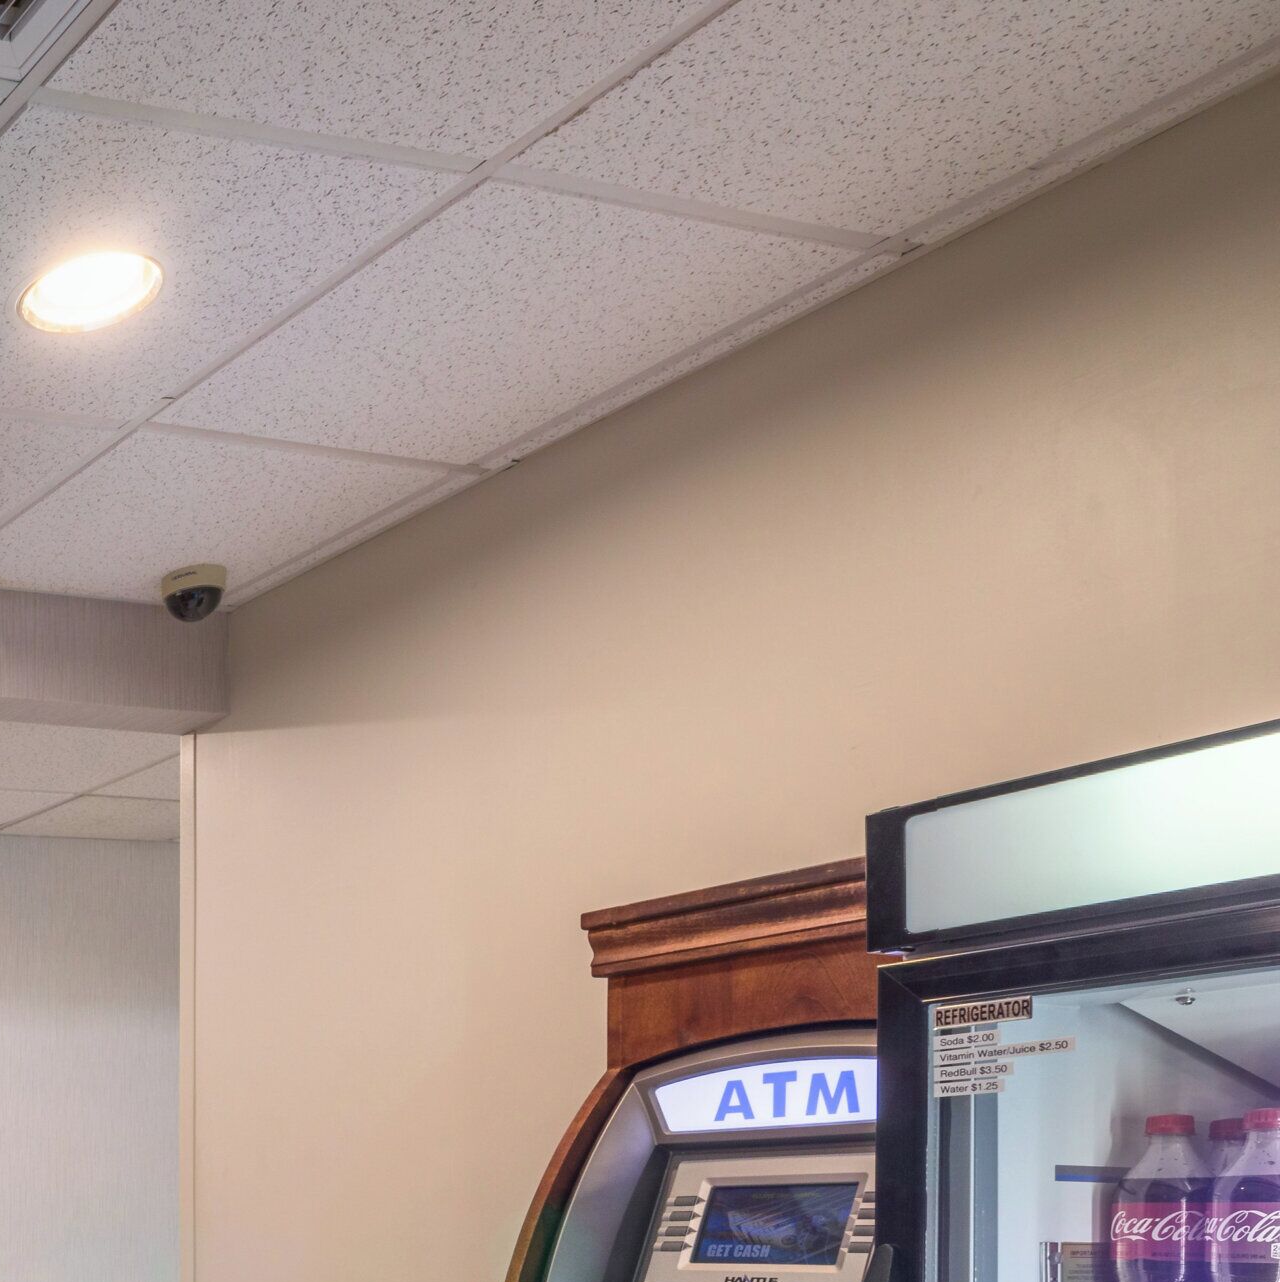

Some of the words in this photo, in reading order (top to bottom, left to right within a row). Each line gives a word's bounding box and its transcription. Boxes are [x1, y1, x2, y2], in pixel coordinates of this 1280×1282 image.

[936, 1000, 1031, 1027] REFRIGERATOR
[940, 1036, 964, 1047] Soda
[967, 1032, 995, 1045] $2.00
[940, 1051, 975, 1063] Vitamin
[977, 1044, 1037, 1059] Water/Juice
[1039, 1040, 1069, 1053] $2.50
[940, 1067, 977, 1079] RedBull
[979, 1064, 1008, 1077] $3.50
[940, 1084, 969, 1095] Water
[971, 1081, 999, 1093] $1.25
[713, 1069, 861, 1123] ATM
[706, 1244, 735, 1258] GET
[736, 1245, 772, 1259] CASH
